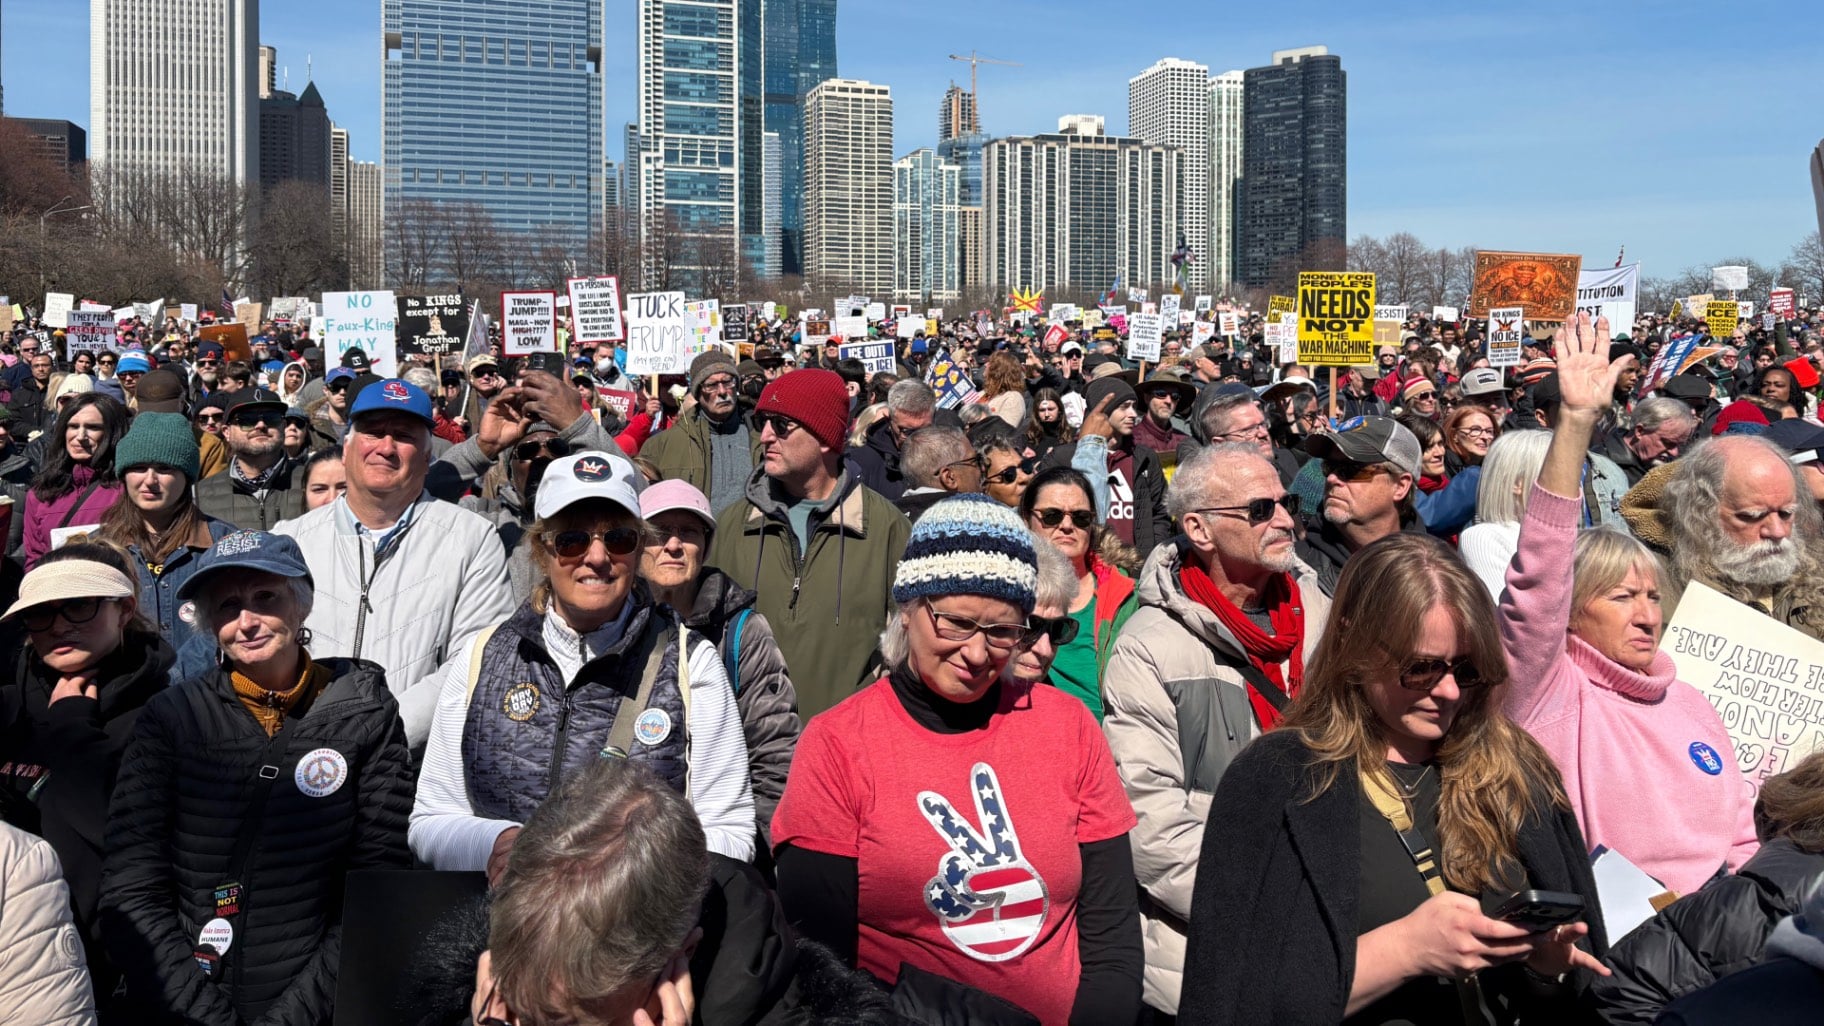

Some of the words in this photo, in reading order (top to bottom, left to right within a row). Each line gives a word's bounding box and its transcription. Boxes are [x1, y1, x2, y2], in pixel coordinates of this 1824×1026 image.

[1300, 280, 1372, 288] PEOPLE'S
[1578, 285, 1624, 300] TITUTION
[347, 294, 372, 309] NO
[407, 299, 419, 307] No
[426, 294, 461, 306] KINGS
[630, 294, 680, 318] TUCK
[1302, 289, 1370, 319] NEEDS
[406, 308, 438, 317] except
[443, 307, 460, 316] for
[509, 307, 549, 316] JUMP!!!!
[1270, 302, 1293, 312] CUBA!
[72, 313, 91, 321] THEY
[1374, 308, 1404, 319] RESIST!
[1706, 309, 1736, 318] ICE
[326, 318, 394, 332] Faux-King
[1306, 320, 1365, 332] NOT
[412, 335, 460, 345] Jonathan
[517, 337, 541, 346] LOW
[631, 325, 683, 354] FRUMP
[1321, 332, 1348, 340] THE
[1491, 332, 1504, 341] NO
[1506, 331, 1520, 341] ICE
[339, 337, 376, 353] WAY
[422, 343, 449, 352] Groff
[1299, 340, 1324, 354] WAR
[1325, 340, 1371, 354] MACHINE
[848, 347, 863, 358] ICE
[865, 345, 886, 357] OUT!
[876, 359, 892, 370] ICE!
[216, 539, 260, 554] RESIST
[1672, 626, 1727, 661] ARE.
[1721, 645, 1798, 684] THEY
[1714, 672, 1780, 706] HOW
[511, 688, 530, 703] MAY
[512, 697, 532, 711] DAY
[214, 890, 228, 899] THIS
[218, 896, 237, 906] NOT
